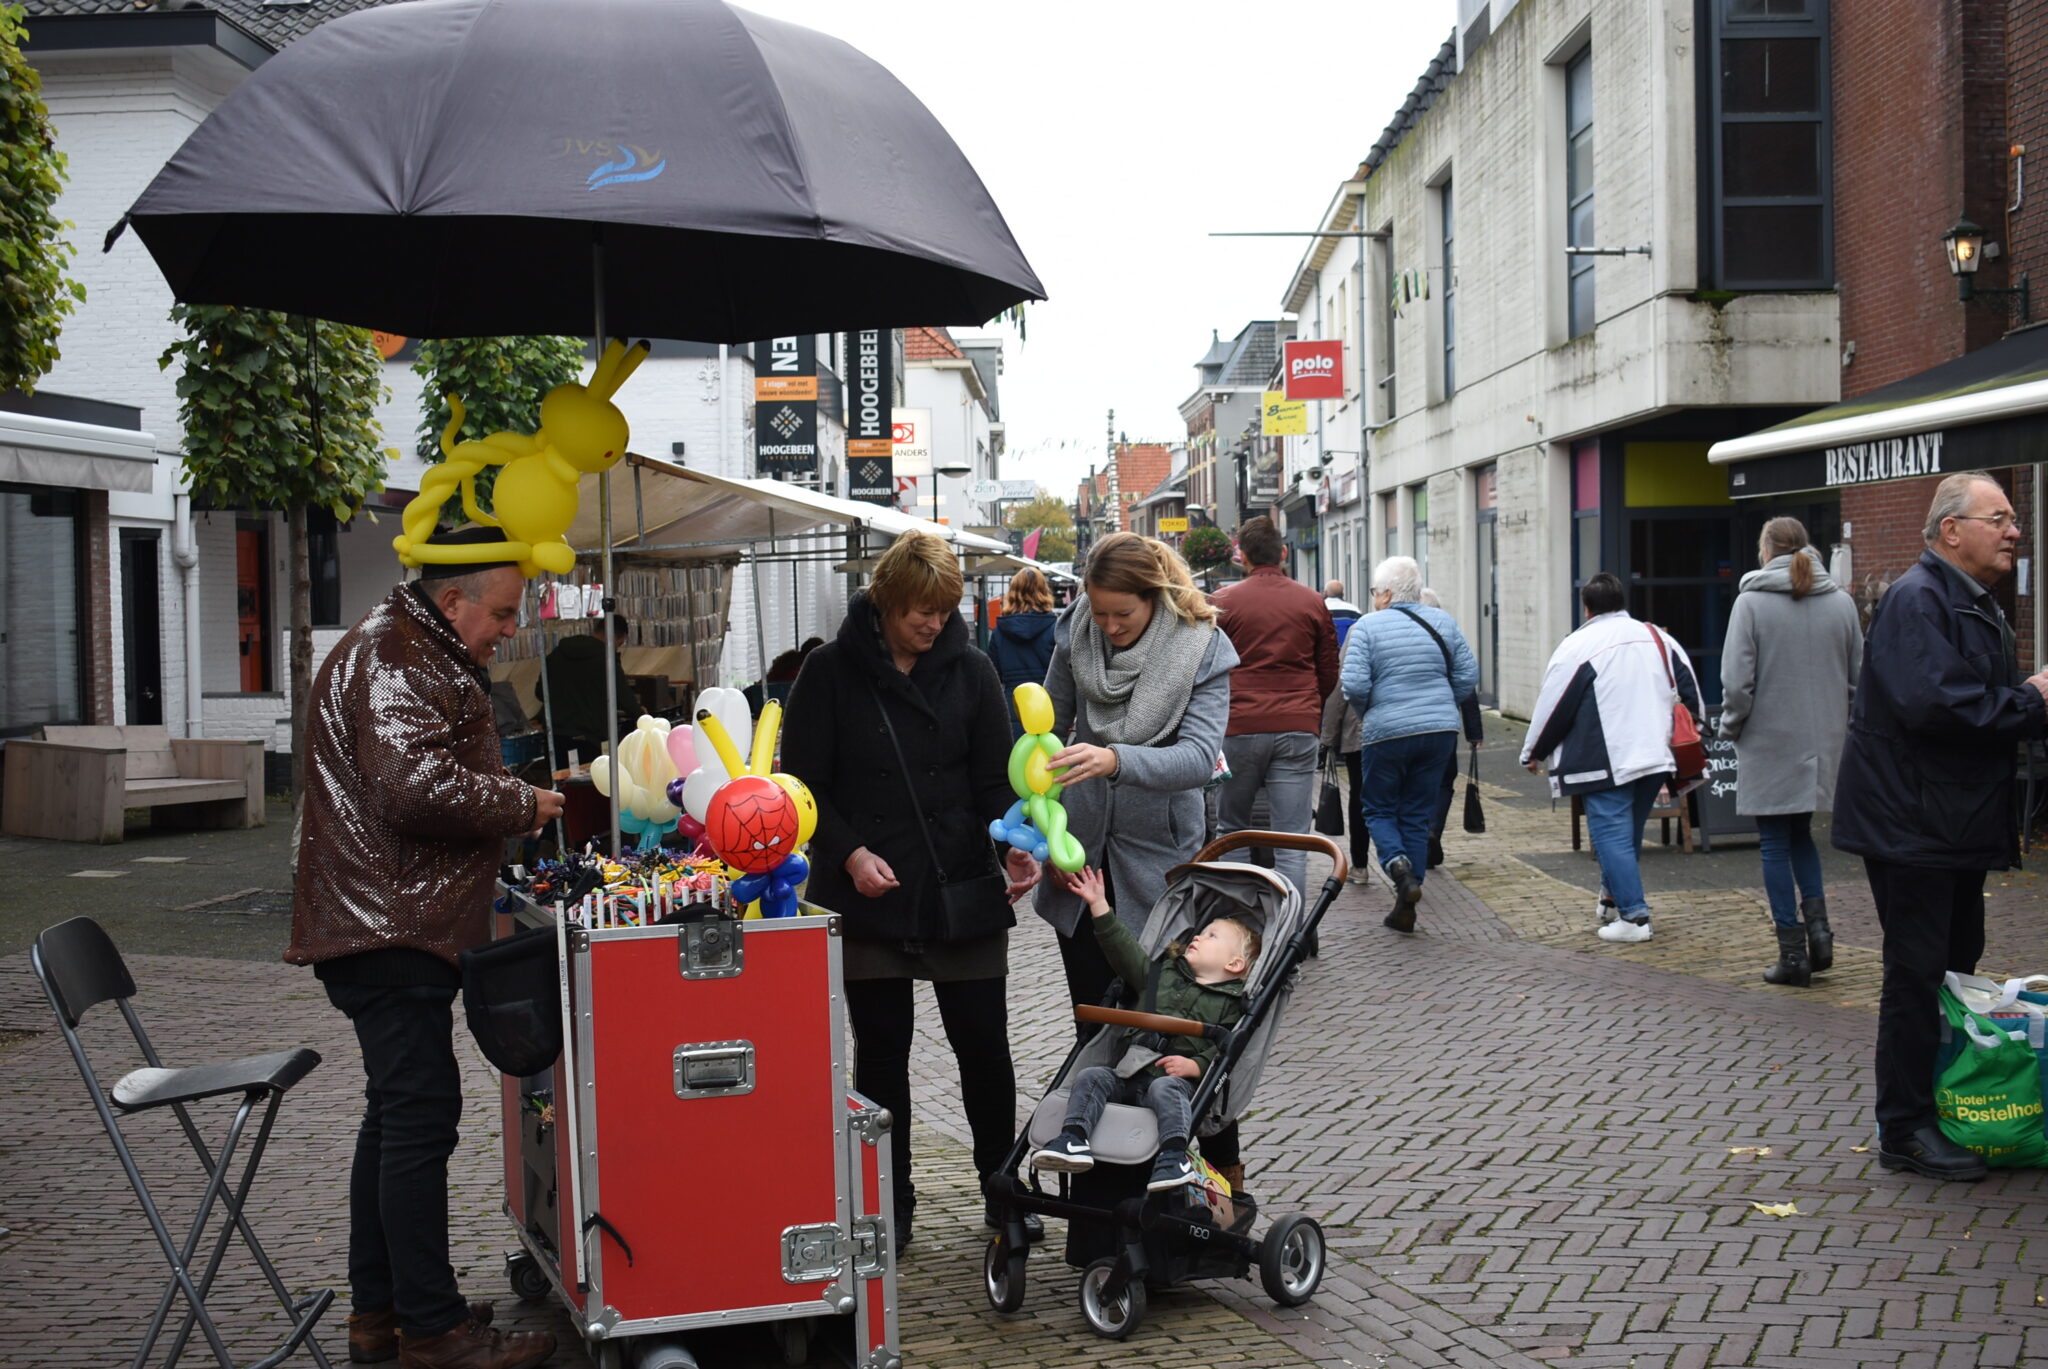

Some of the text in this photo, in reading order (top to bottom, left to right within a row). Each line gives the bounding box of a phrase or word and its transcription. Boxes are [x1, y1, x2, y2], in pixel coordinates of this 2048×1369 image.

[1291, 354, 1334, 375] polo
[859, 329, 880, 436] HOOGEBEE
[759, 444, 814, 456] HOOGEBEEN
[894, 449, 927, 457] ANDERS
[1825, 432, 1944, 486] RESTAURANT
[851, 487, 892, 496] HOOGEBEEN
[1955, 1094, 1987, 1106] hotel
